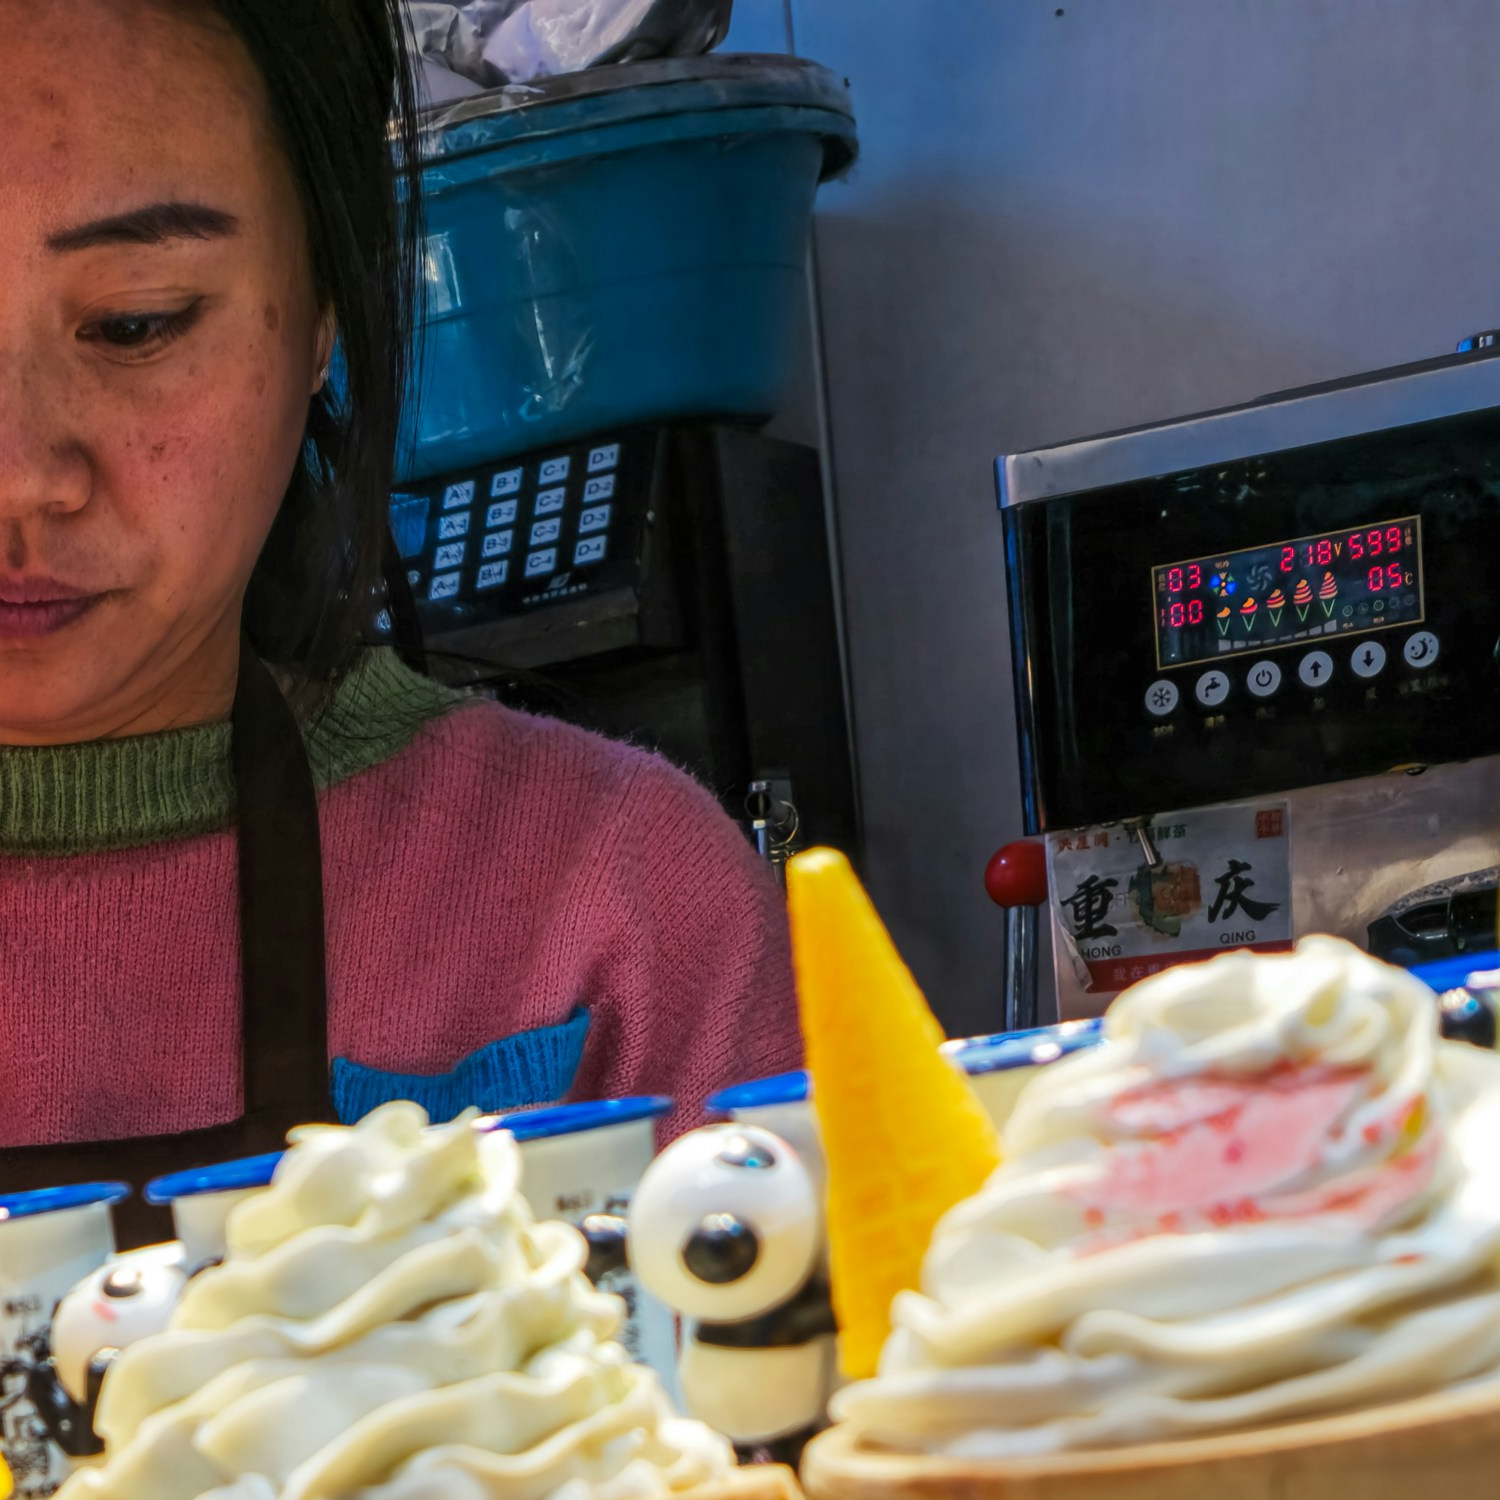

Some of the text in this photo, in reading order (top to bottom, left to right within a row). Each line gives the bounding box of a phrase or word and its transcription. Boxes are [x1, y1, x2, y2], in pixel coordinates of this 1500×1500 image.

[592, 451, 615, 465] D-1
[1168, 564, 1201, 592] 03
[1348, 526, 1401, 560] 599
[1060, 859, 1281, 939] 重 庆
[1080, 929, 1256, 959] HONG QING
